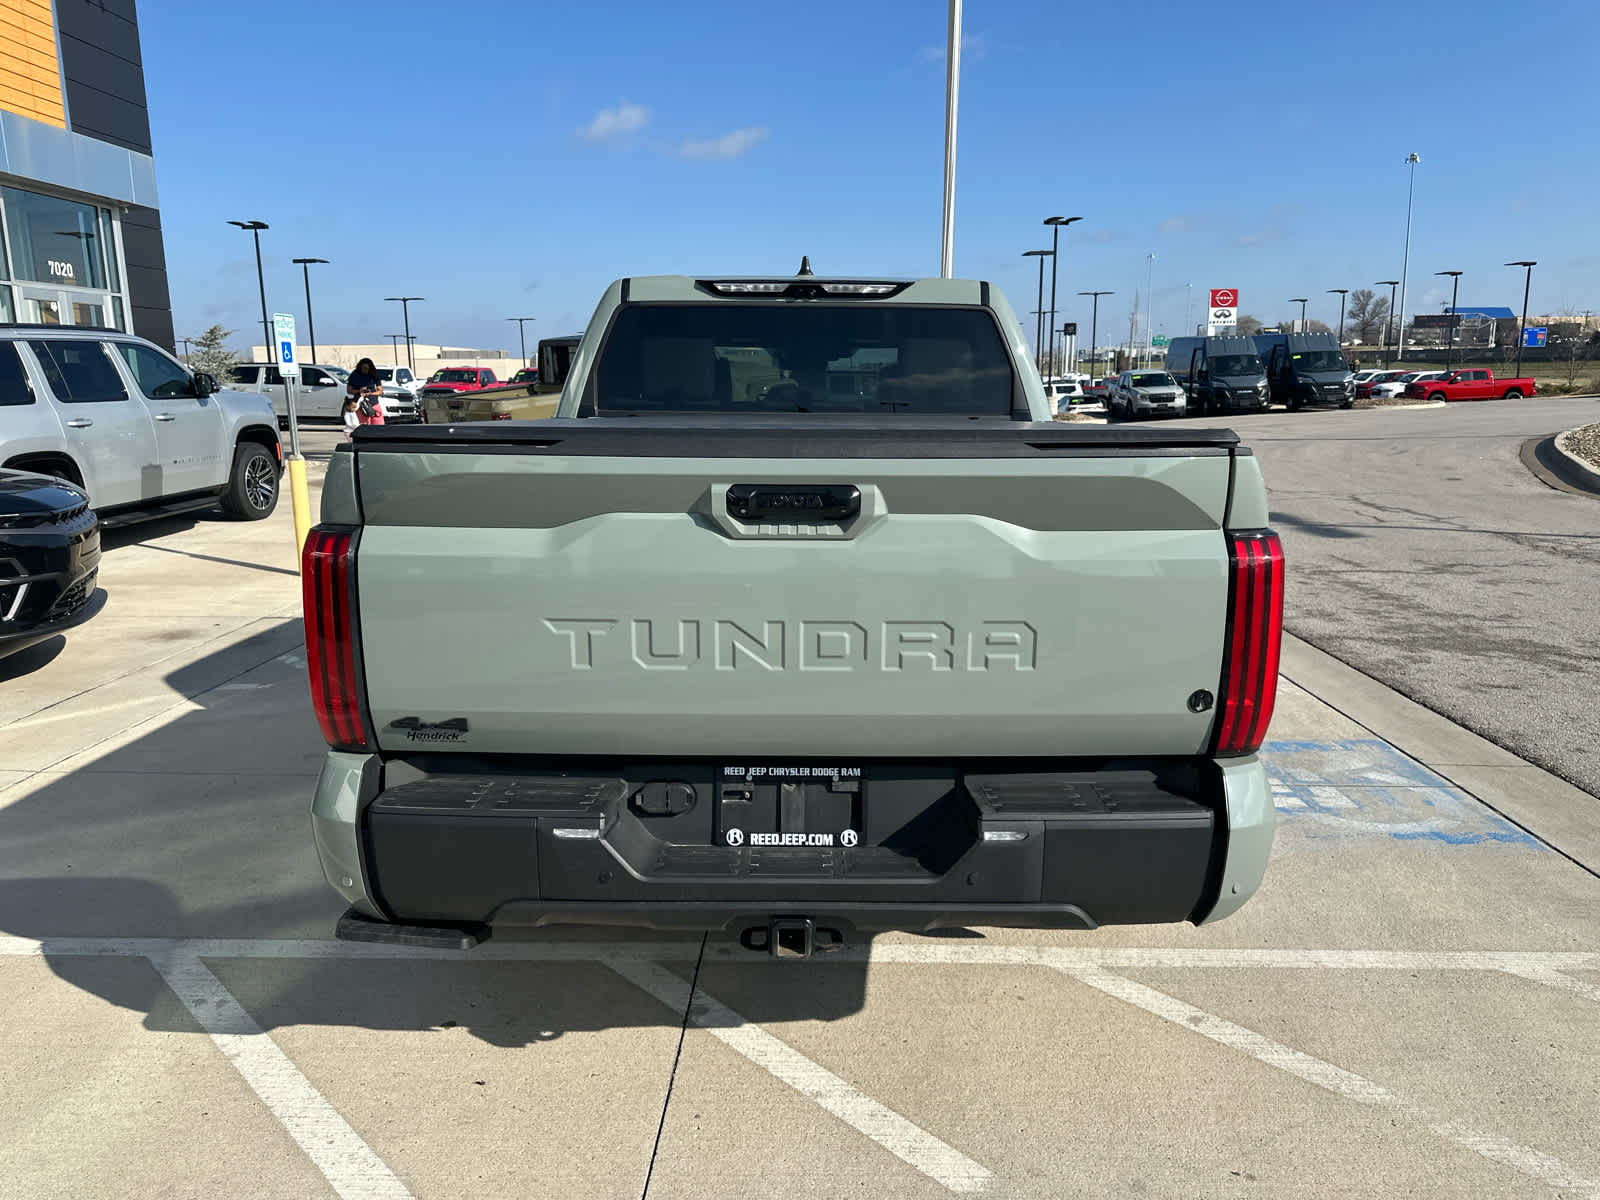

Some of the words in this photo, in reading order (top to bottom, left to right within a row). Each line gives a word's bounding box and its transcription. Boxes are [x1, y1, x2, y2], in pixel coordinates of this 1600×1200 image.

[47, 260, 74, 278] 7020
[541, 618, 1038, 671] TUNDRA
[724, 766, 745, 776] REED
[747, 767, 767, 776] JEEP
[768, 767, 810, 777] CHRYSLER
[811, 767, 840, 777] DODGE
[841, 767, 861, 777] RAM
[750, 833, 834, 846] REEDJEEP.COM
